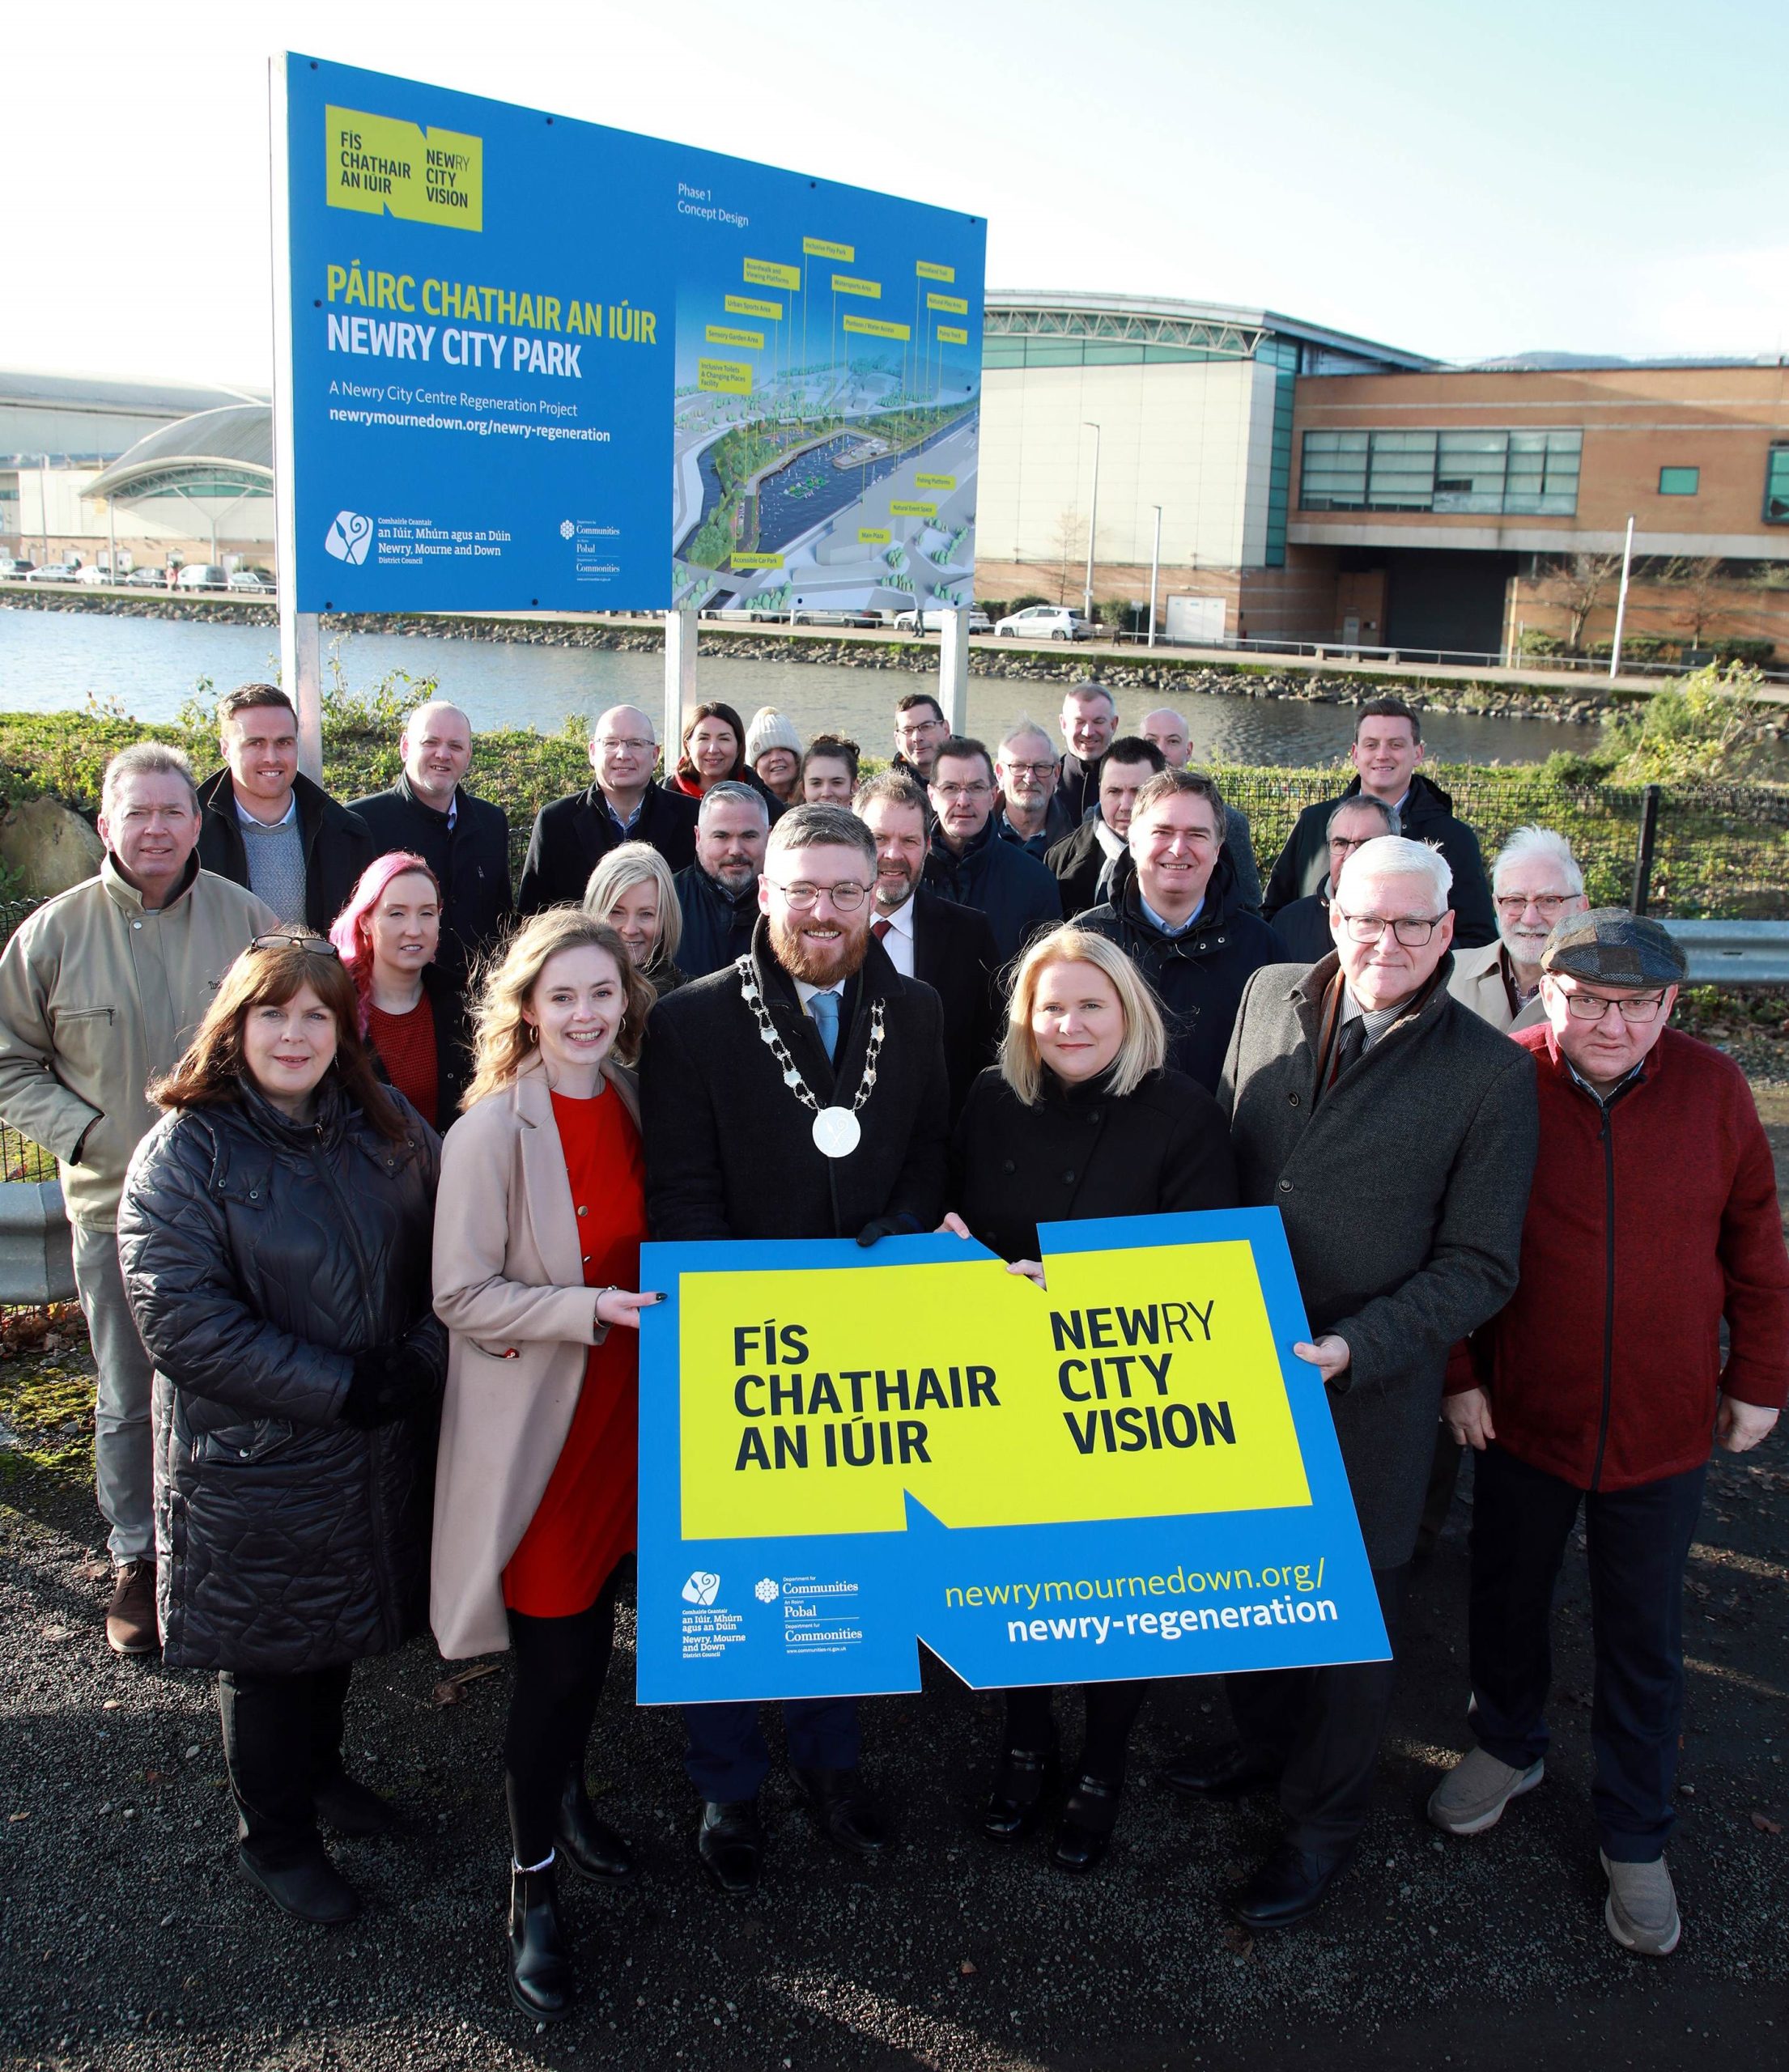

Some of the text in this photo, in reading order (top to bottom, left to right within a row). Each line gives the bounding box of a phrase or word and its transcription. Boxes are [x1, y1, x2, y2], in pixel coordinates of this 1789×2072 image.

[341, 151, 411, 179] CHATHAIR
[427, 149, 470, 172] NEWRY
[341, 171, 360, 188] AN
[426, 168, 456, 188] CITY
[426, 185, 468, 208] VISION
[678, 182, 711, 202] Phase 1
[678, 200, 749, 228] Concept Design
[827, 246, 835, 255] Play
[836, 248, 846, 256] Park
[327, 258, 657, 345] PÁIRC CHATHAIR AN IÚIR
[728, 299, 742, 308] Urban
[743, 302, 759, 311] Sports
[708, 330, 729, 340] Sensory
[729, 333, 747, 342] Garden
[328, 313, 582, 379] NEWRY CITY PARK
[701, 363, 740, 373] Inclusive Toilets
[701, 379, 719, 388] Facility
[706, 372, 730, 382] Changing
[730, 374, 746, 382] Places
[329, 380, 578, 418] A Newry City Centre Regeneration Project
[329, 409, 610, 442] newrymournedown.org/newry-regeneration
[377, 517, 432, 526] Comhairle Ceantair
[576, 524, 620, 535] Communities
[378, 527, 511, 542] an Iúir, Mhúrn agus an Dúin
[378, 542, 501, 556] Newry, Mourne and Down
[576, 543, 596, 554] Pobal
[576, 563, 620, 573] Commonities
[1050, 1300, 1214, 1351] NEWRY
[733, 1318, 810, 1366] FÍS
[1058, 1353, 1172, 1402] CITY
[733, 1365, 1001, 1417] CHATHAIR
[1063, 1401, 1236, 1454] VISION
[734, 1416, 933, 1471] AN IÚIR
[783, 1581, 859, 1594] Communities
[945, 1556, 1324, 1610] newrymournedown.org/
[695, 1615, 712, 1624] Iúir,
[714, 1614, 742, 1623] Mhúrn
[784, 1605, 817, 1618] Pobal
[1007, 1594, 1338, 1645] newry-regeneration
[682, 1624, 702, 1633] agus
[716, 1622, 737, 1631] Dúin
[785, 1628, 863, 1641] Commonities
[682, 1634, 746, 1645] Newry, Mourne
[682, 1643, 725, 1652] and Down
